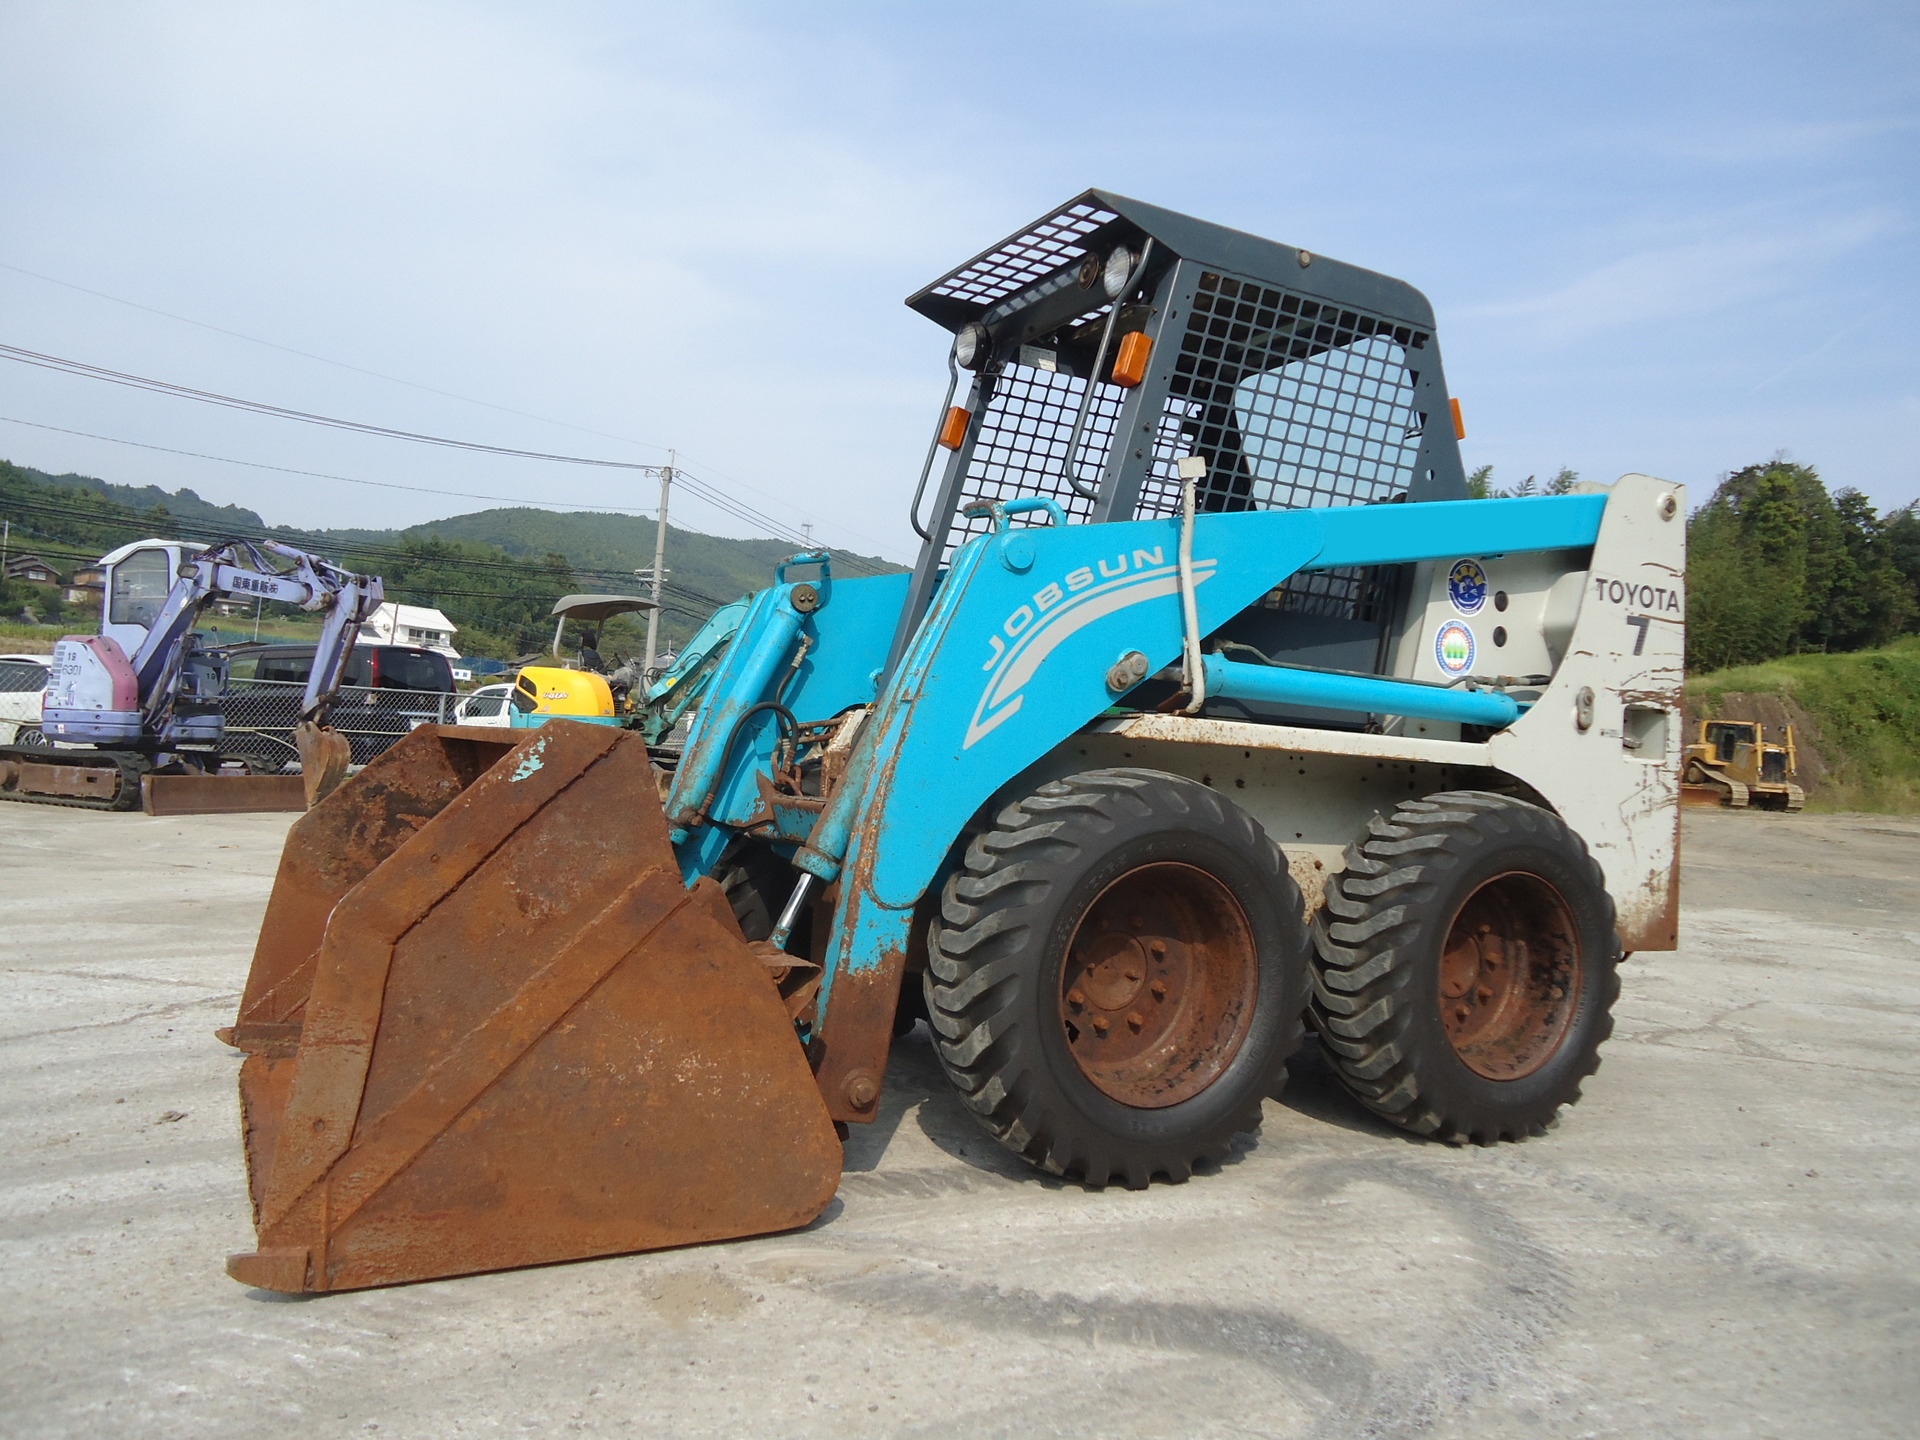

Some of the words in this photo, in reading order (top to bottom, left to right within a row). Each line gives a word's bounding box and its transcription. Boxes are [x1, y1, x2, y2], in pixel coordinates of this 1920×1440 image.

[983, 546, 1164, 671] JOBSUN
[1596, 578, 1680, 613] TOYOTA
[1626, 615, 1650, 656] 7
[68, 652, 77, 661] 19
